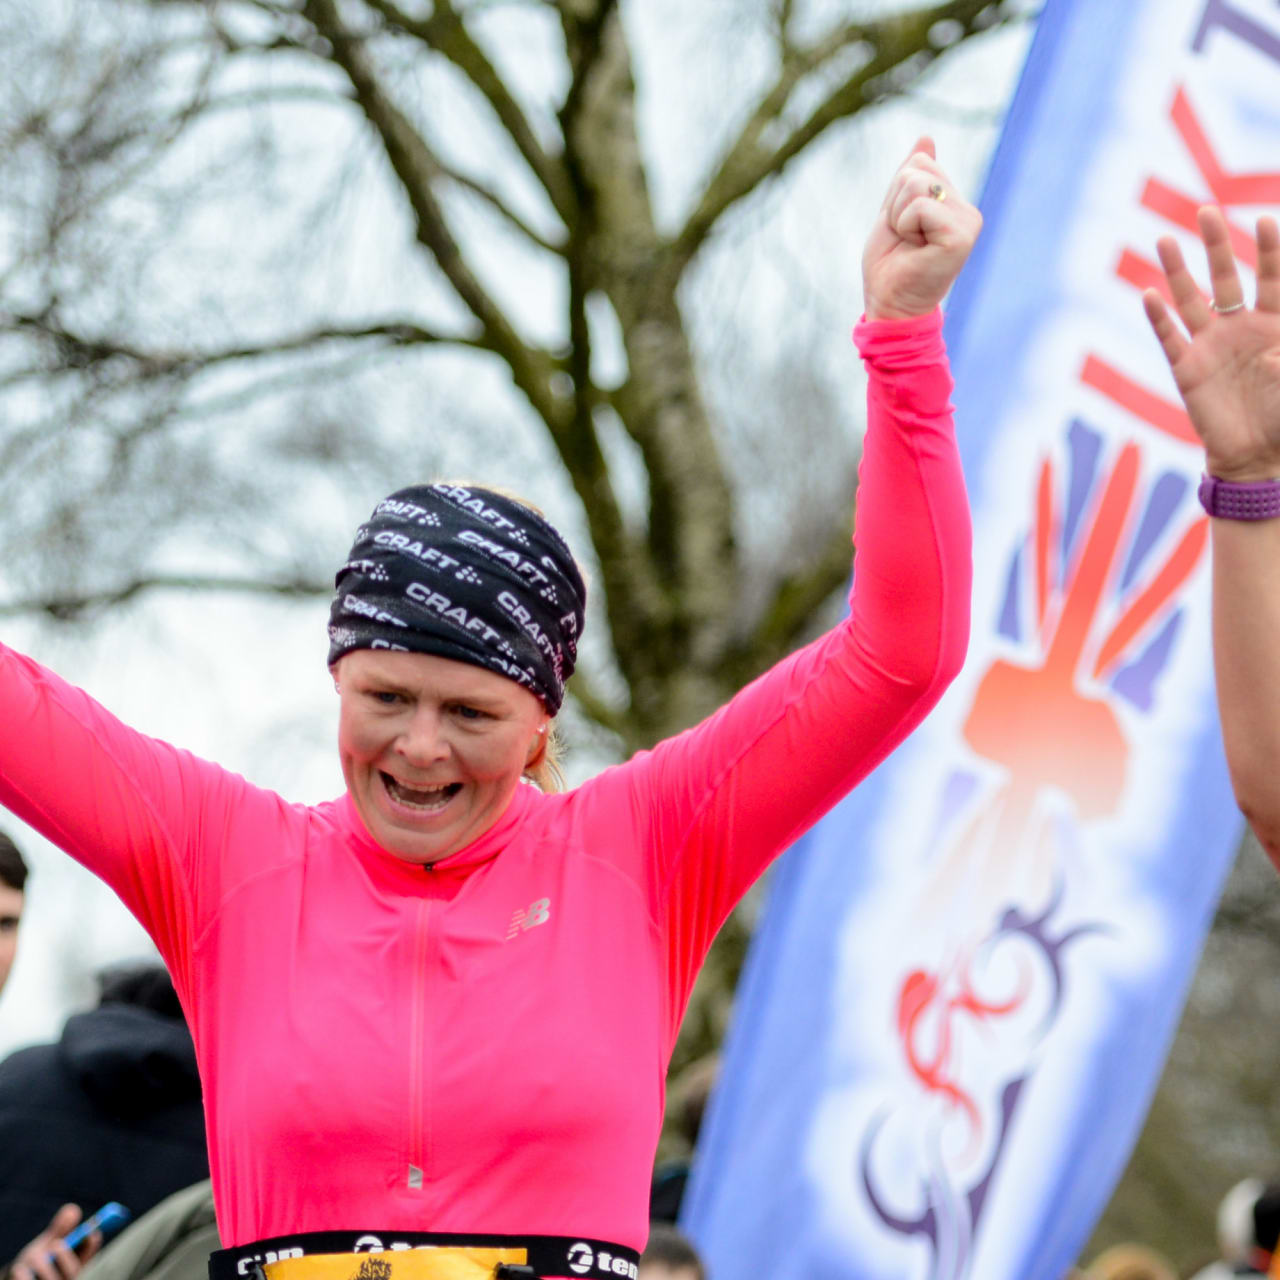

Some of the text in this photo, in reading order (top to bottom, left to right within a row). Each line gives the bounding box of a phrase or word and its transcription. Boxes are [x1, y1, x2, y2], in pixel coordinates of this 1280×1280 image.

[374, 532, 460, 569] CRAFT
[405, 582, 501, 641] CRAFT
[497, 591, 556, 658] CRAFT
